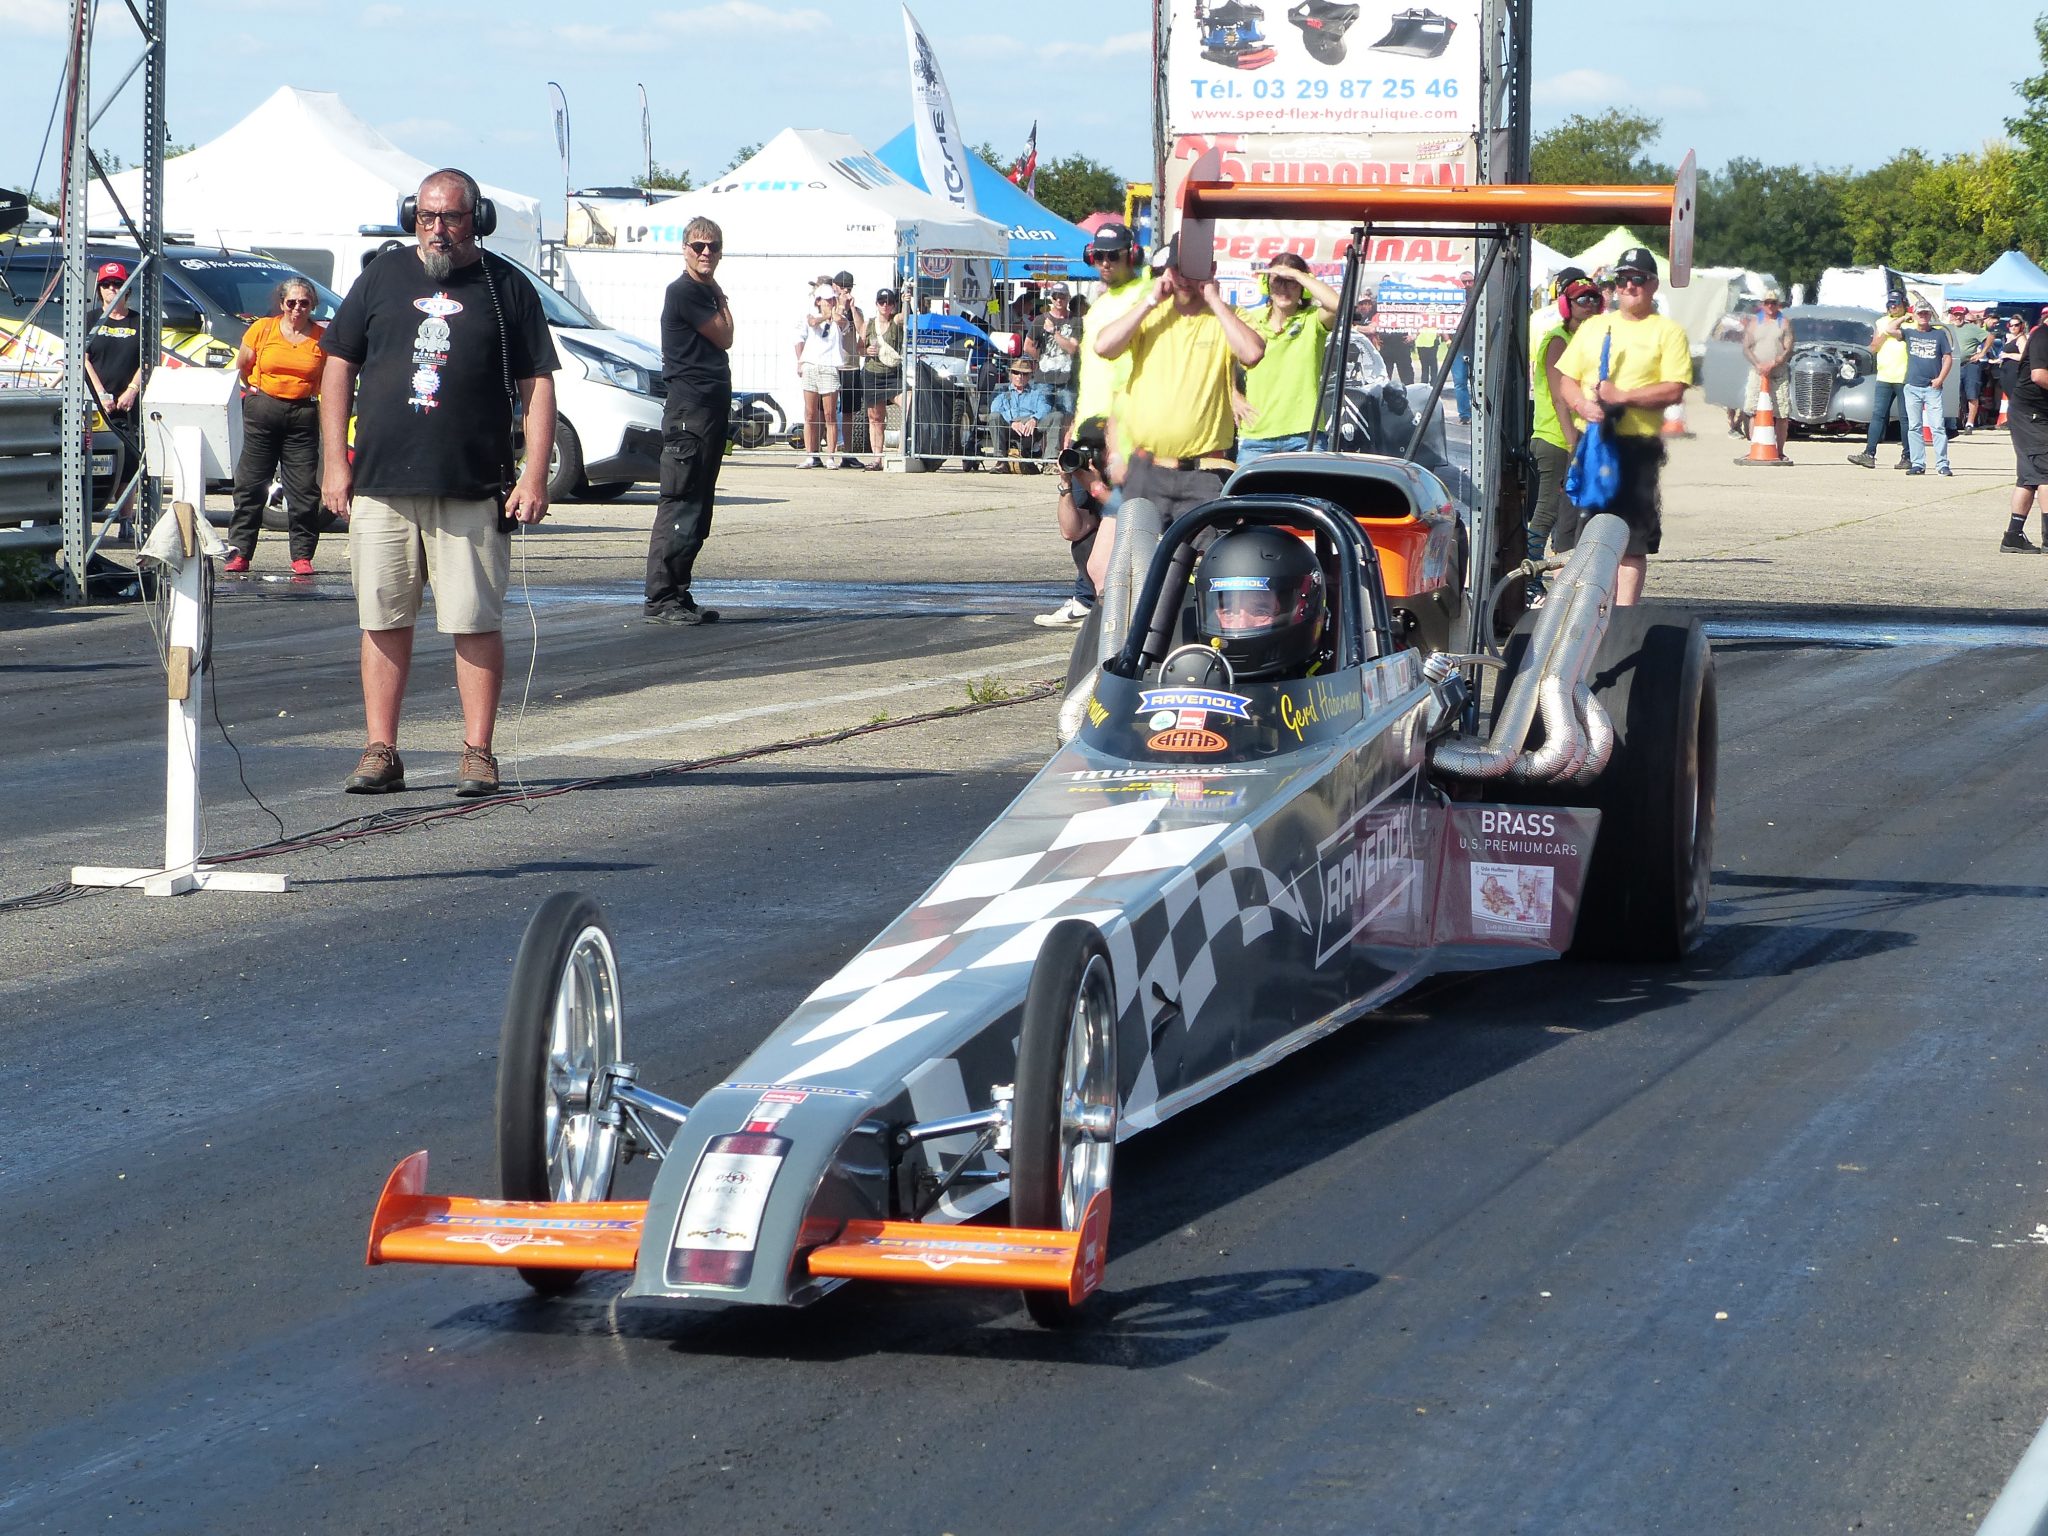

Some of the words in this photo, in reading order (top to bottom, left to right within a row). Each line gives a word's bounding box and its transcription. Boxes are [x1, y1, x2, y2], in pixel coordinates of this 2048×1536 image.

[1190, 79, 1242, 99] Tél.
[1253, 79, 1285, 98] 03
[1296, 79, 1329, 98] 29
[1340, 79, 1373, 98] 87
[1382, 78, 1415, 98] 25
[1425, 78, 1459, 98] 46
[1191, 107, 1458, 122] www.speed-flex-hydraulique.com
[1151, 694, 1236, 710] RAVENOL
[1280, 689, 1319, 742] Gerd
[1068, 766, 1268, 781] Milwaukee
[1481, 810, 1555, 837] BRASS
[1459, 838, 1482, 850] U.S.
[1484, 839, 1542, 854] PREMIUM
[1545, 842, 1578, 856] CARS
[1327, 805, 1410, 923] RAVENOL
[737, 1084, 849, 1095] RAVENOL
[450, 1217, 620, 1229] RAVENOL
[879, 1239, 1056, 1255] RAVENOL
